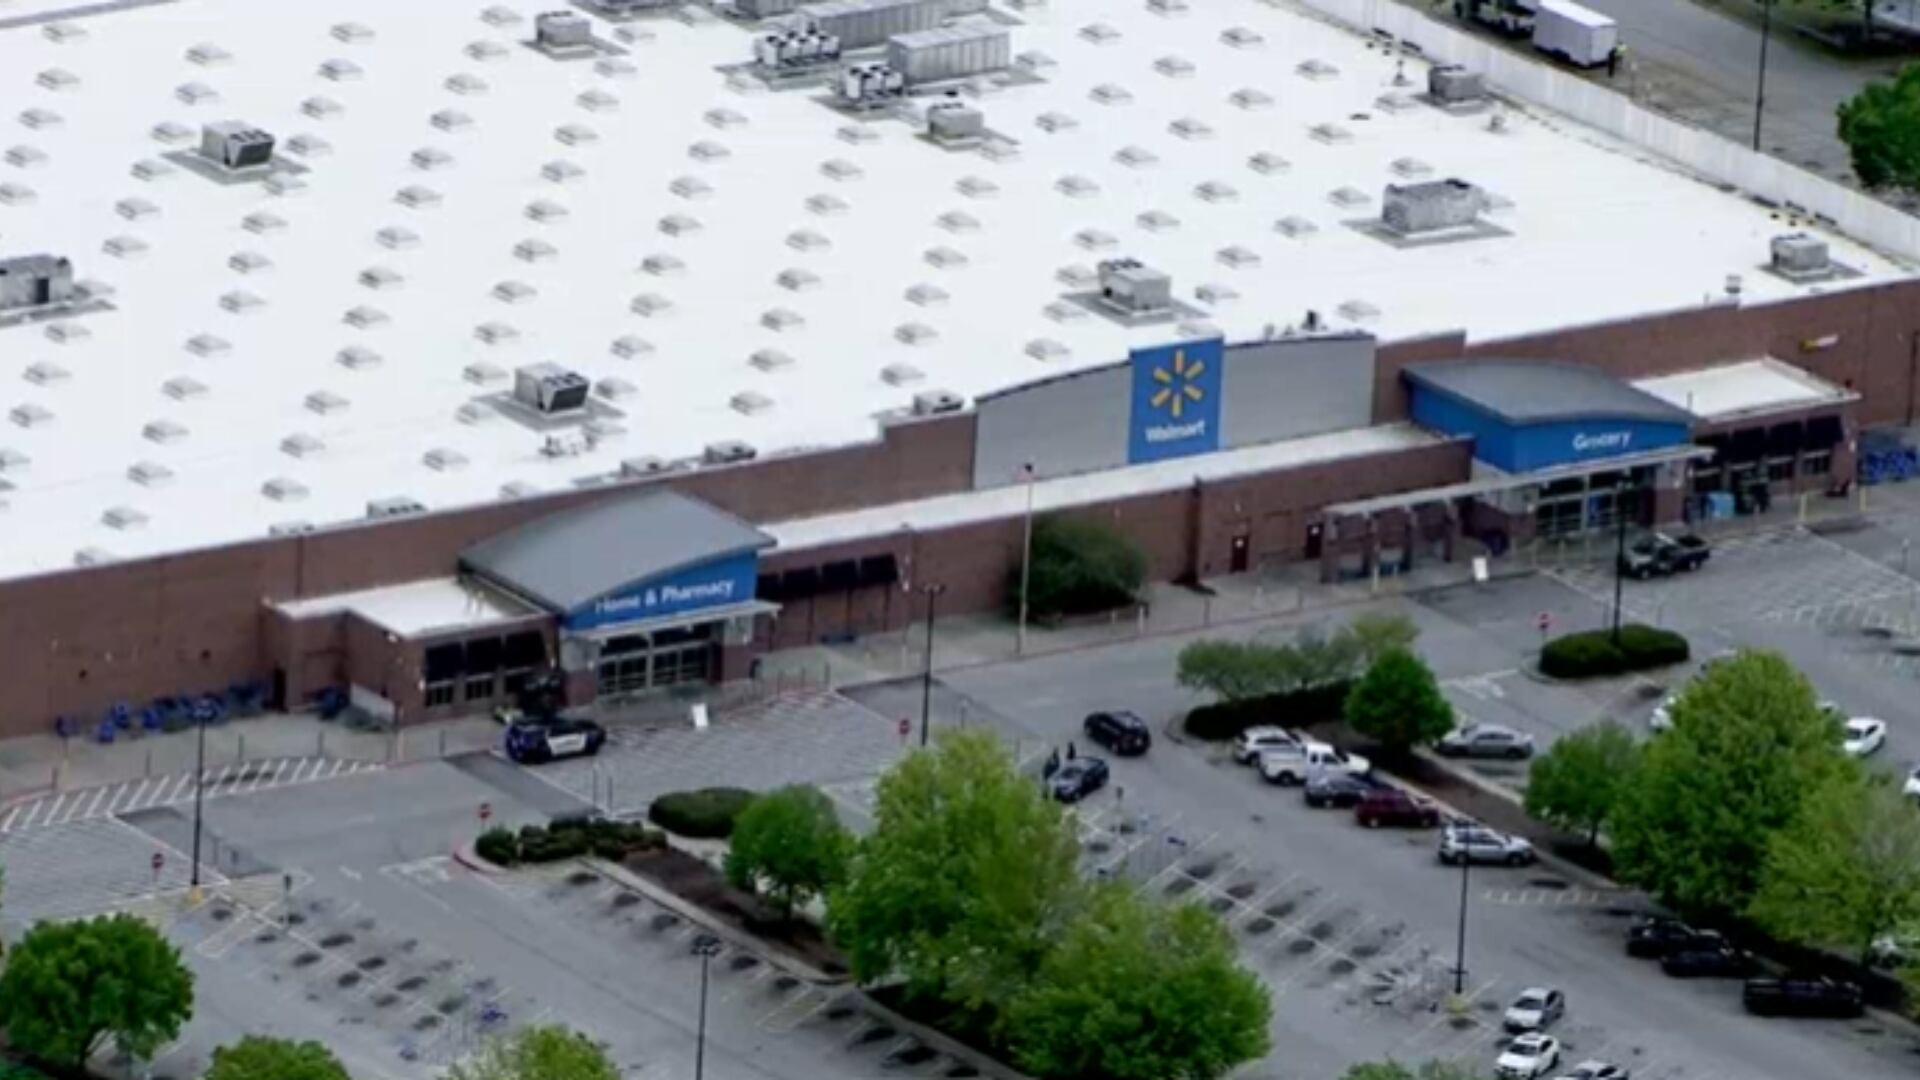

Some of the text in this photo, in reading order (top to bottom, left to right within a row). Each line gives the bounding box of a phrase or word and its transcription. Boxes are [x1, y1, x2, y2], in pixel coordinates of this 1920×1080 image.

[1145, 419, 1206, 443] Walmart
[1572, 431, 1632, 451] Grocery
[645, 587, 658, 607] &
[661, 579, 736, 603] Pharmacy
